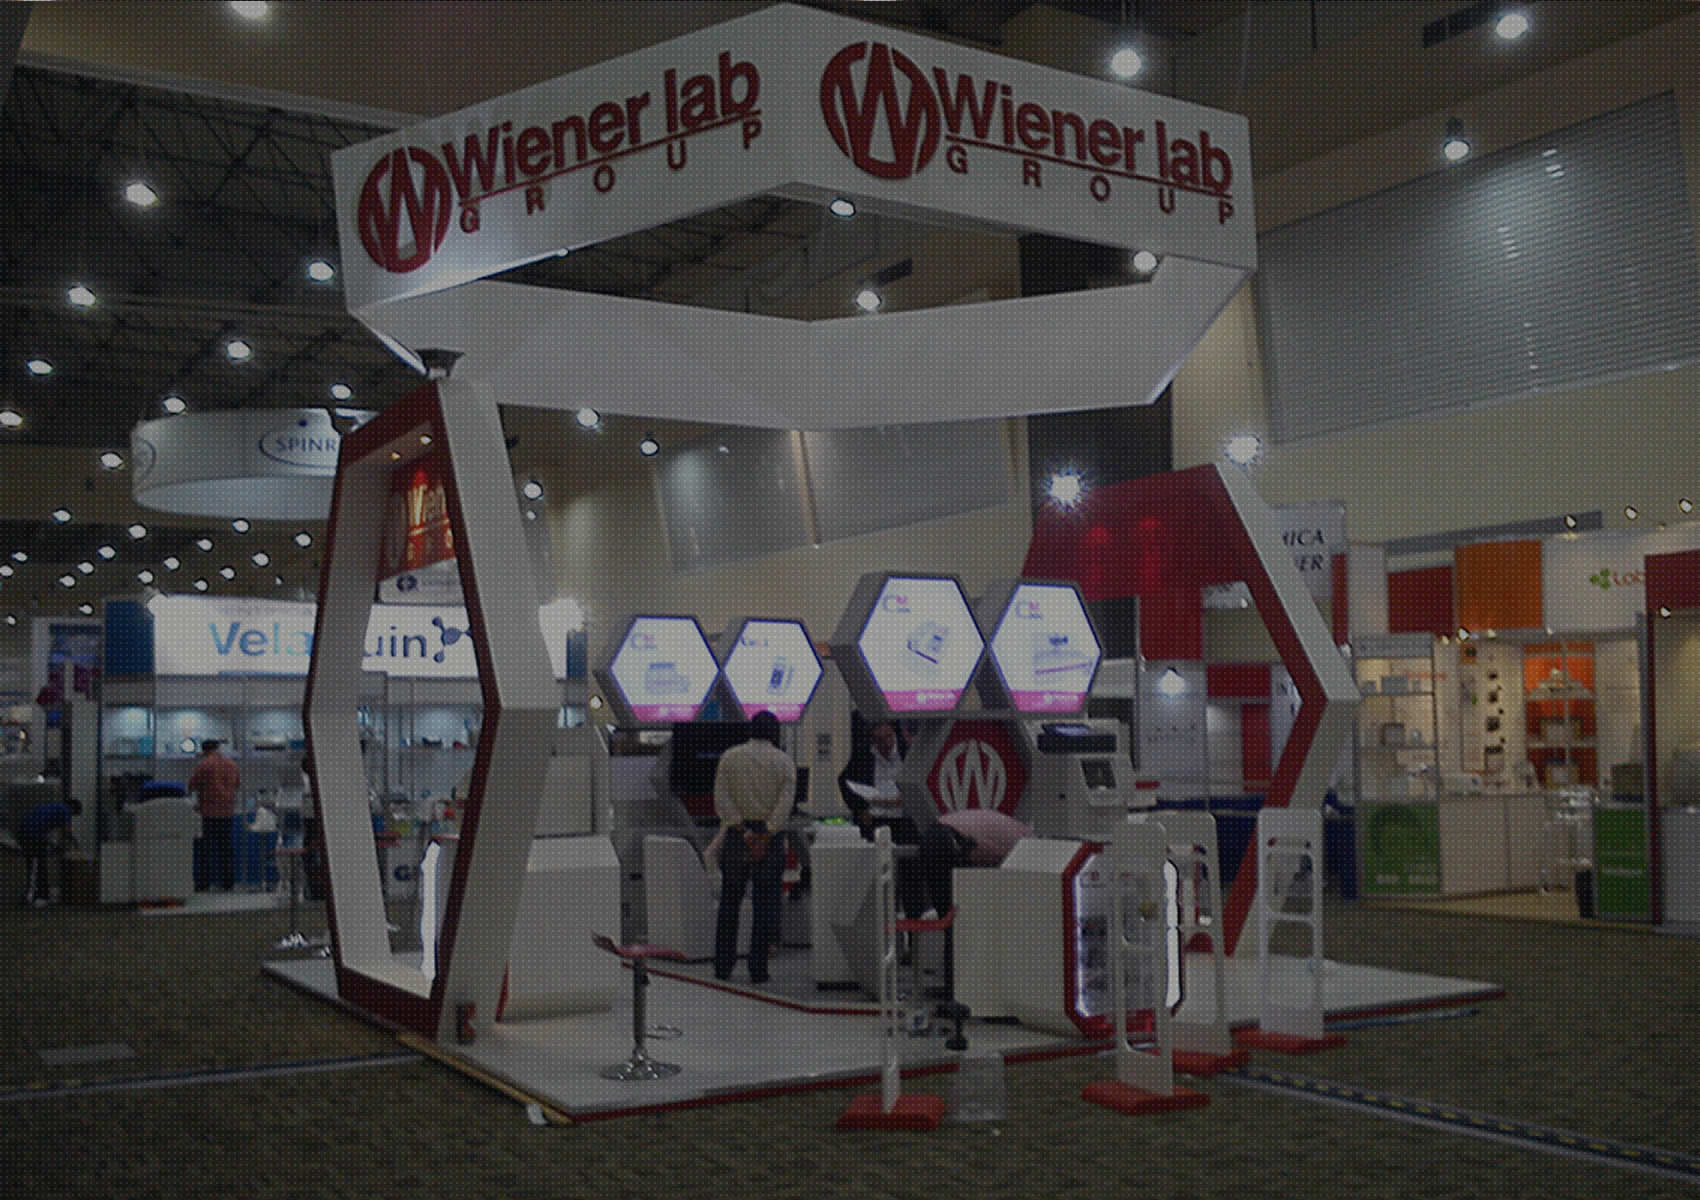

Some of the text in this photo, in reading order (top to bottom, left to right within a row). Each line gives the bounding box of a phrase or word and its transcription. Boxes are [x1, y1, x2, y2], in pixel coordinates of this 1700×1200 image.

[442, 51, 760, 201] Wiener lab
[933, 66, 1233, 194] Wiener lab
